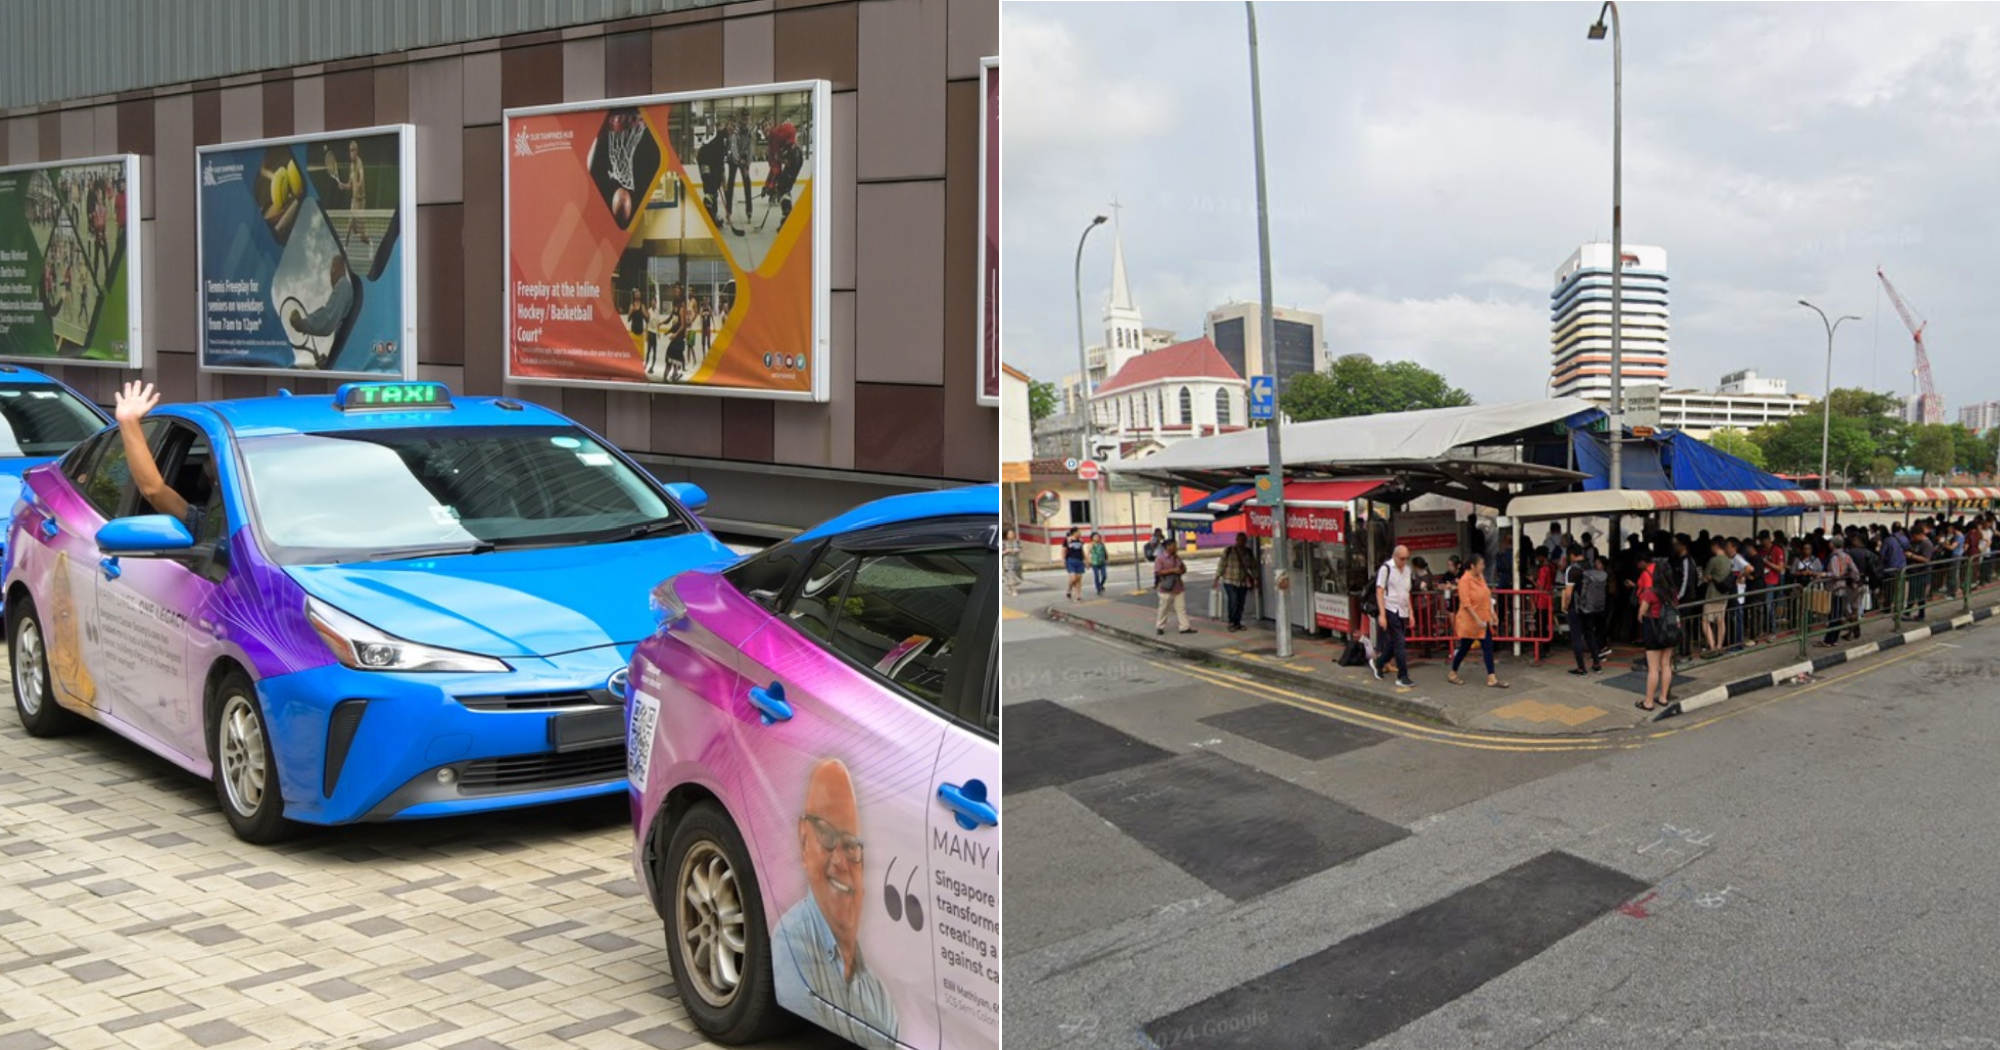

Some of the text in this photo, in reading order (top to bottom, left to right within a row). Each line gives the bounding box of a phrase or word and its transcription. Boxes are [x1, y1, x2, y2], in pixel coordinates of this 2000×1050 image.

[208, 279, 259, 296] Tennis Freeplay for
[517, 281, 600, 300] Freeplay at the Inline
[208, 298, 264, 315] seniors on weekdays
[517, 304, 593, 323] Hockey / Basketball
[208, 317, 222, 331] from
[222, 318, 235, 331] 7am
[235, 319, 243, 331] to
[360, 385, 434, 403] TAXI
[1286, 513, 1308, 530] Johore
[1308, 513, 1339, 533] Express
[155, 607, 189, 630] LEGACY
[933, 827, 990, 869] MANY
[935, 869, 996, 908] Singapore
[936, 895, 999, 935] transforme
[939, 922, 997, 958] creating a
[941, 946, 984, 977] against
